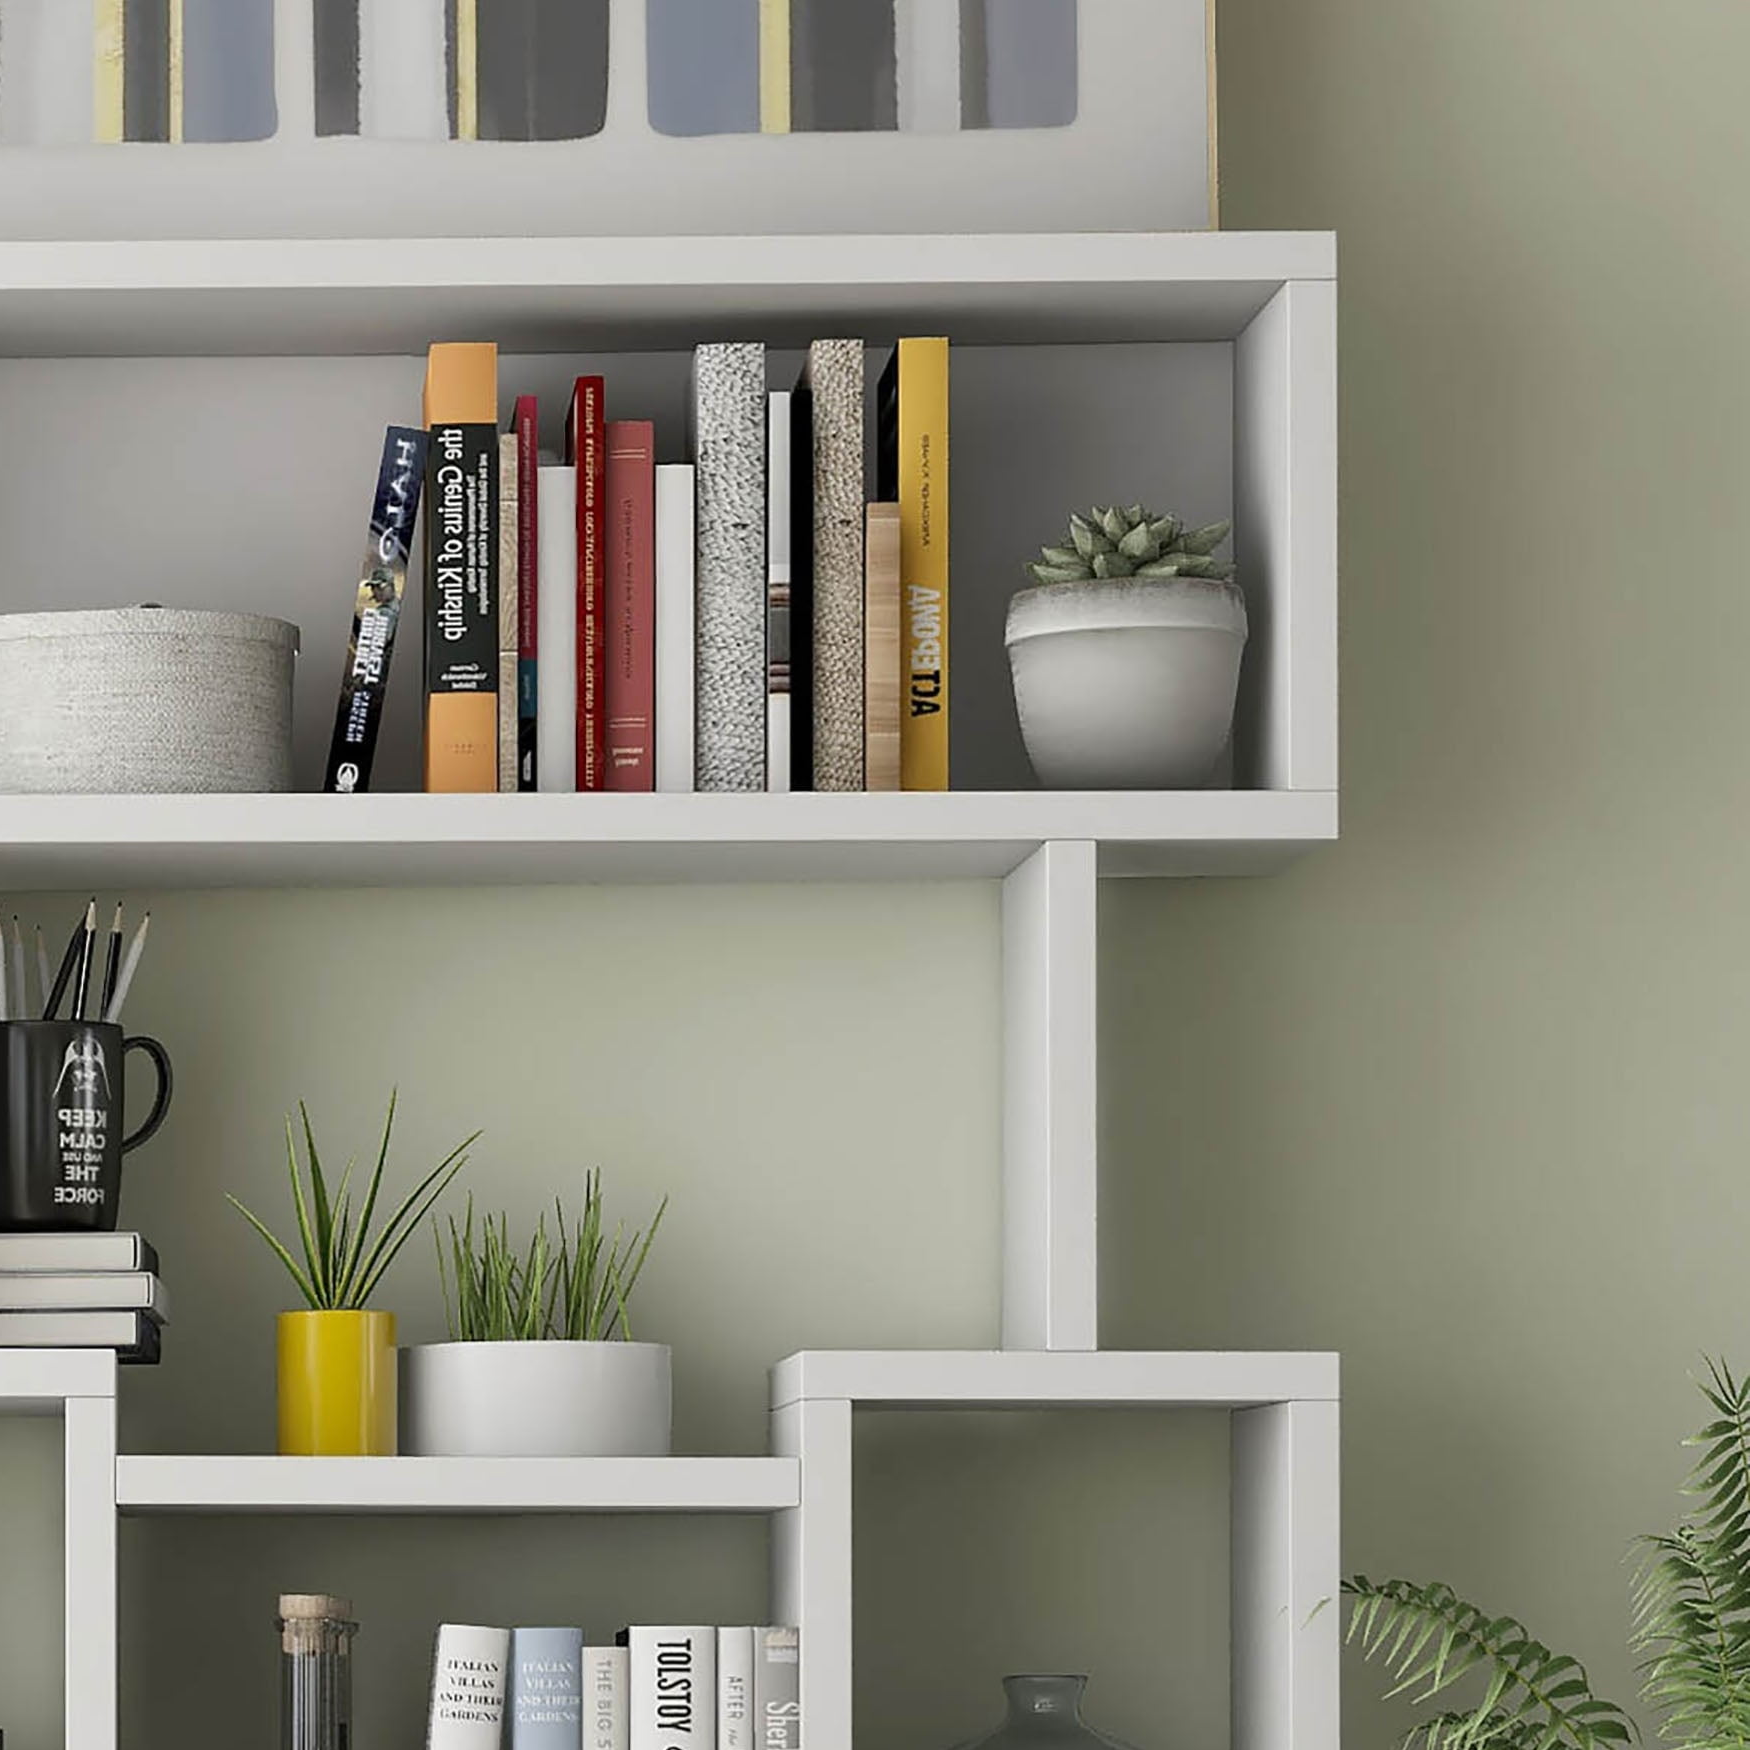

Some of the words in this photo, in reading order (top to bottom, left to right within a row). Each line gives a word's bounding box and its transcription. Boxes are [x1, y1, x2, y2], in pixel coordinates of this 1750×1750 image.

[597, 1660, 612, 1692] THE
[656, 1637, 692, 1733] TOLSTOY
[597, 1698, 612, 1730] BIG
[727, 1676, 744, 1719] AFTER
